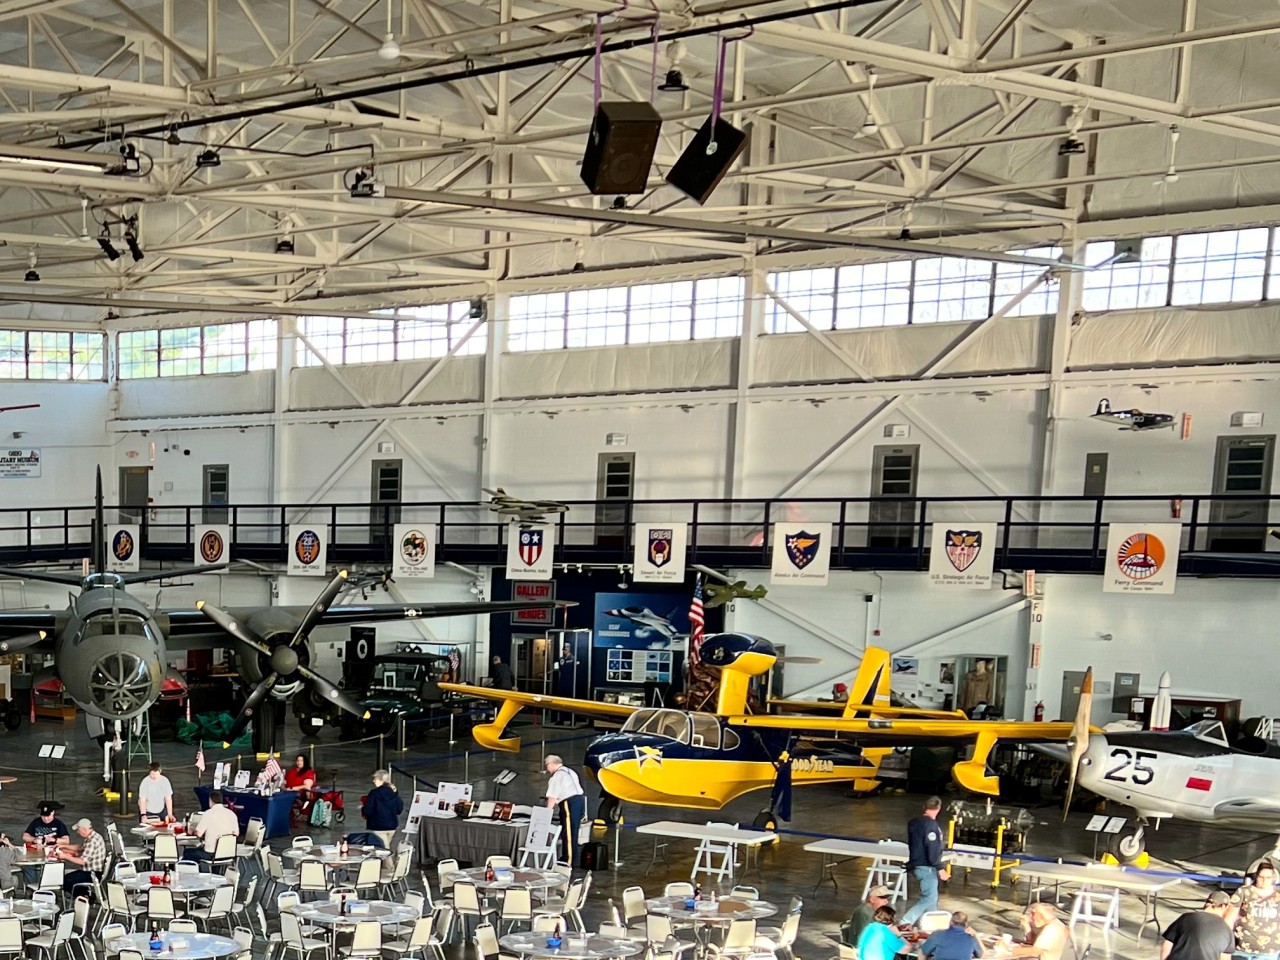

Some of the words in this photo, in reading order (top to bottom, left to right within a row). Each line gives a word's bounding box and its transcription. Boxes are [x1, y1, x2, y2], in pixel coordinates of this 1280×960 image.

[1114, 579, 1130, 587] Ferry
[1132, 579, 1164, 587] Command
[516, 585, 550, 597] GALLERY
[726, 604, 736, 613] 10
[1033, 602, 1040, 611] F
[1031, 613, 1042, 623] 10
[791, 755, 834, 773] OODYEAR
[1103, 748, 1157, 785] 25
